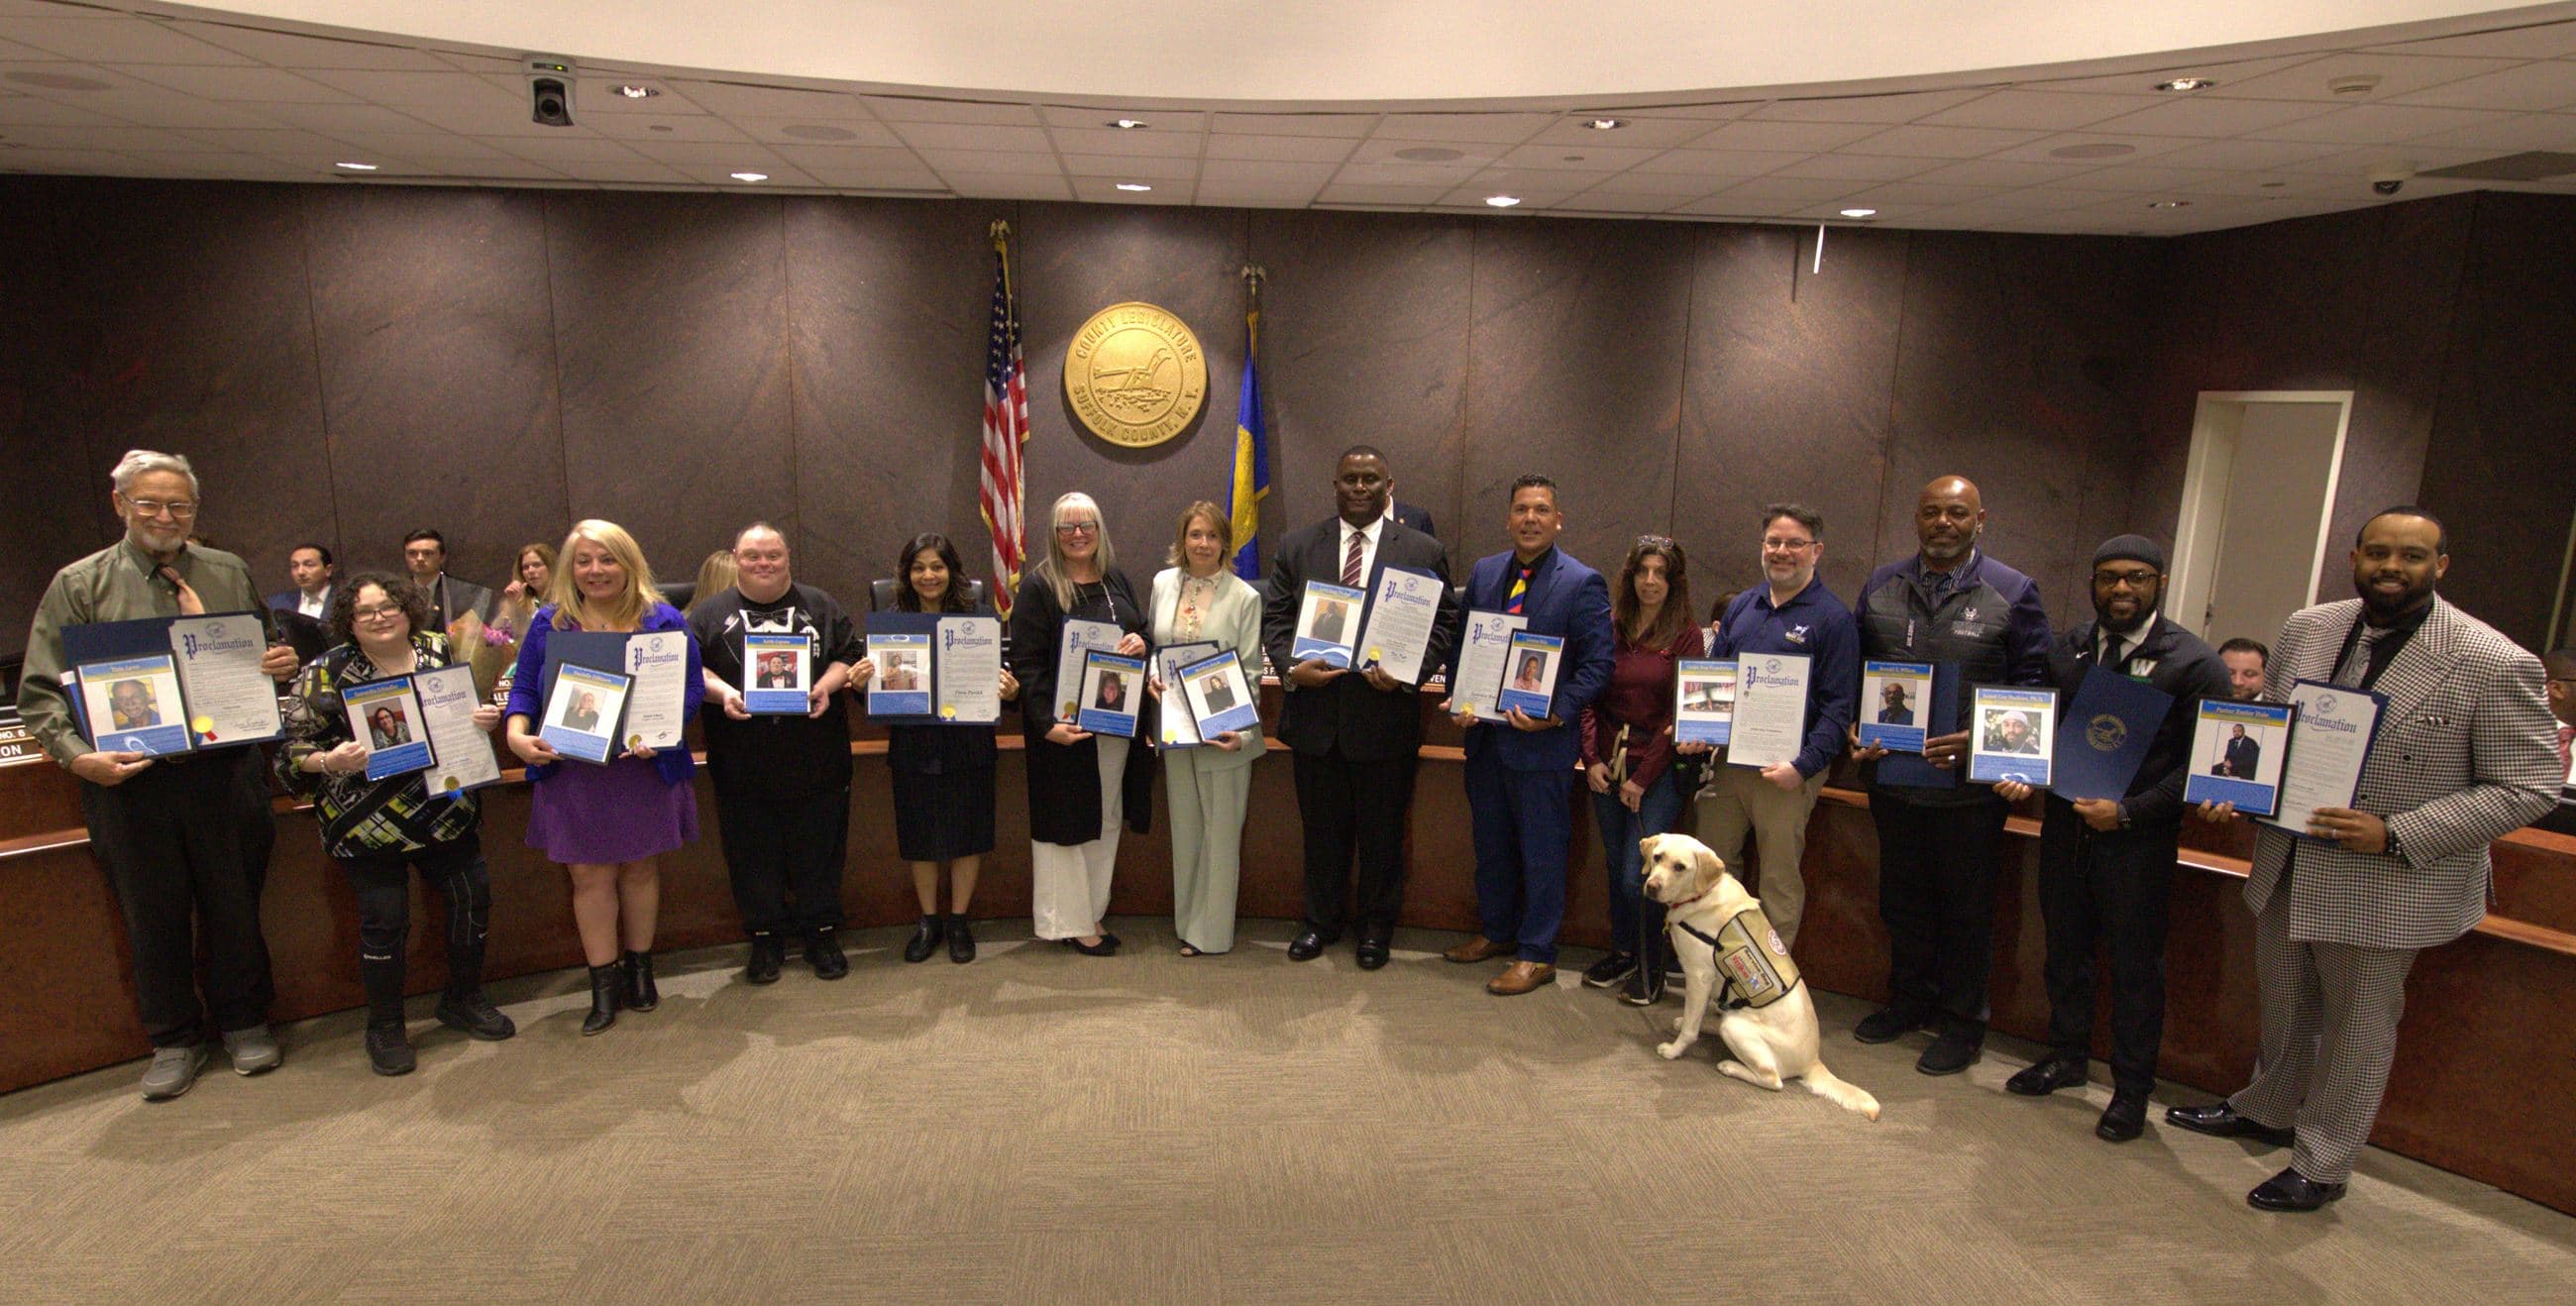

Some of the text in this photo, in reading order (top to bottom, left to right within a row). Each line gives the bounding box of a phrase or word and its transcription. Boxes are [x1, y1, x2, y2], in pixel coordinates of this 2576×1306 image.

[1075, 310, 1197, 363] COUNTY LEGISLATURE
[1073, 382, 1118, 437] SUFFOLK
[1122, 421, 1179, 442] COUNTY,
[1384, 581, 1433, 608] Proclamation
[183, 634, 254, 660] Proclamation
[944, 629, 993, 651] Proclamation
[1070, 631, 1115, 654] Proclamation
[633, 647, 679, 672] Proclamation
[2130, 658, 2158, 677] W
[1746, 665, 1799, 690] Proclamation
[419, 690, 467, 708] roclamation
